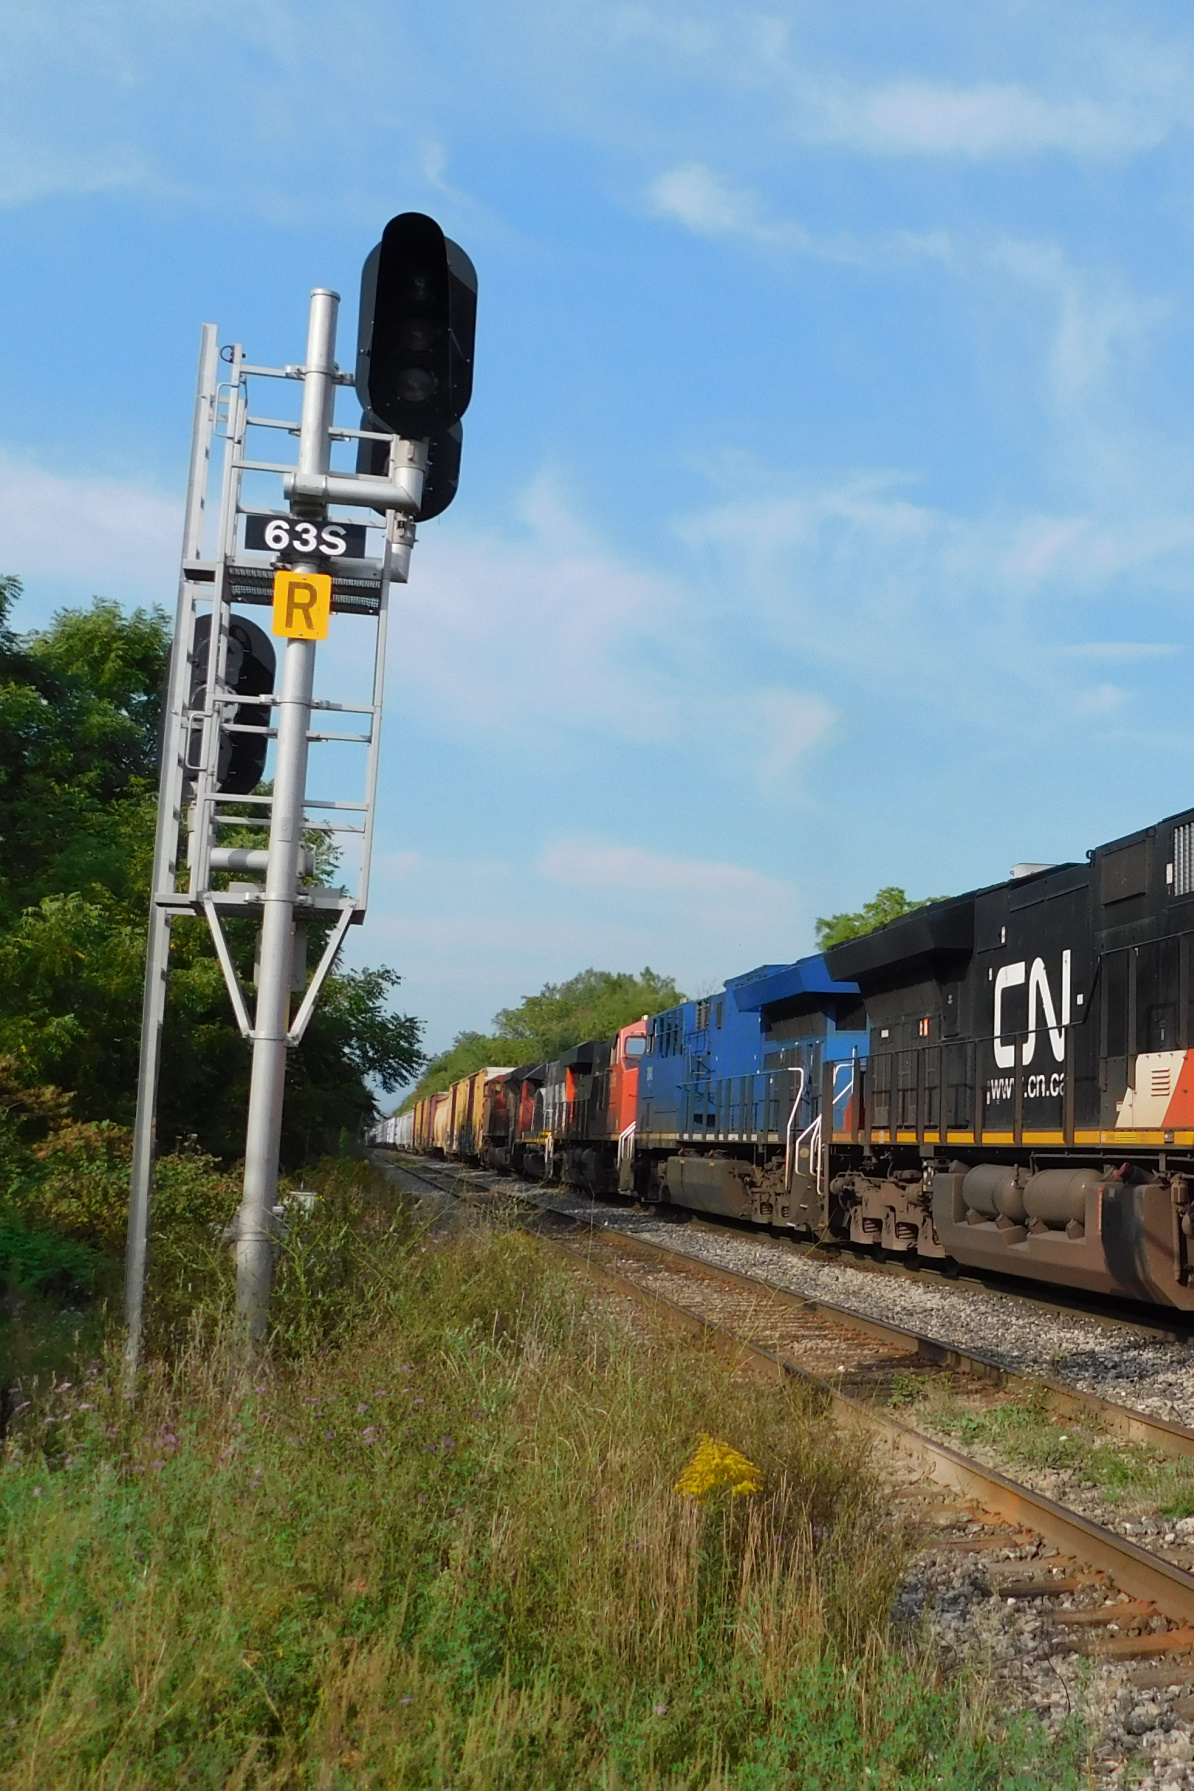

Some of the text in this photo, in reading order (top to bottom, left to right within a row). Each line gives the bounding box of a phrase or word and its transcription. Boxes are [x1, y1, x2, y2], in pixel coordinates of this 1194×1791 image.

[264, 520, 347, 556] 63S
[285, 581, 318, 630] R
[994, 949, 1071, 1069] CN
[990, 1072, 1065, 1100] ww.cn.ca
